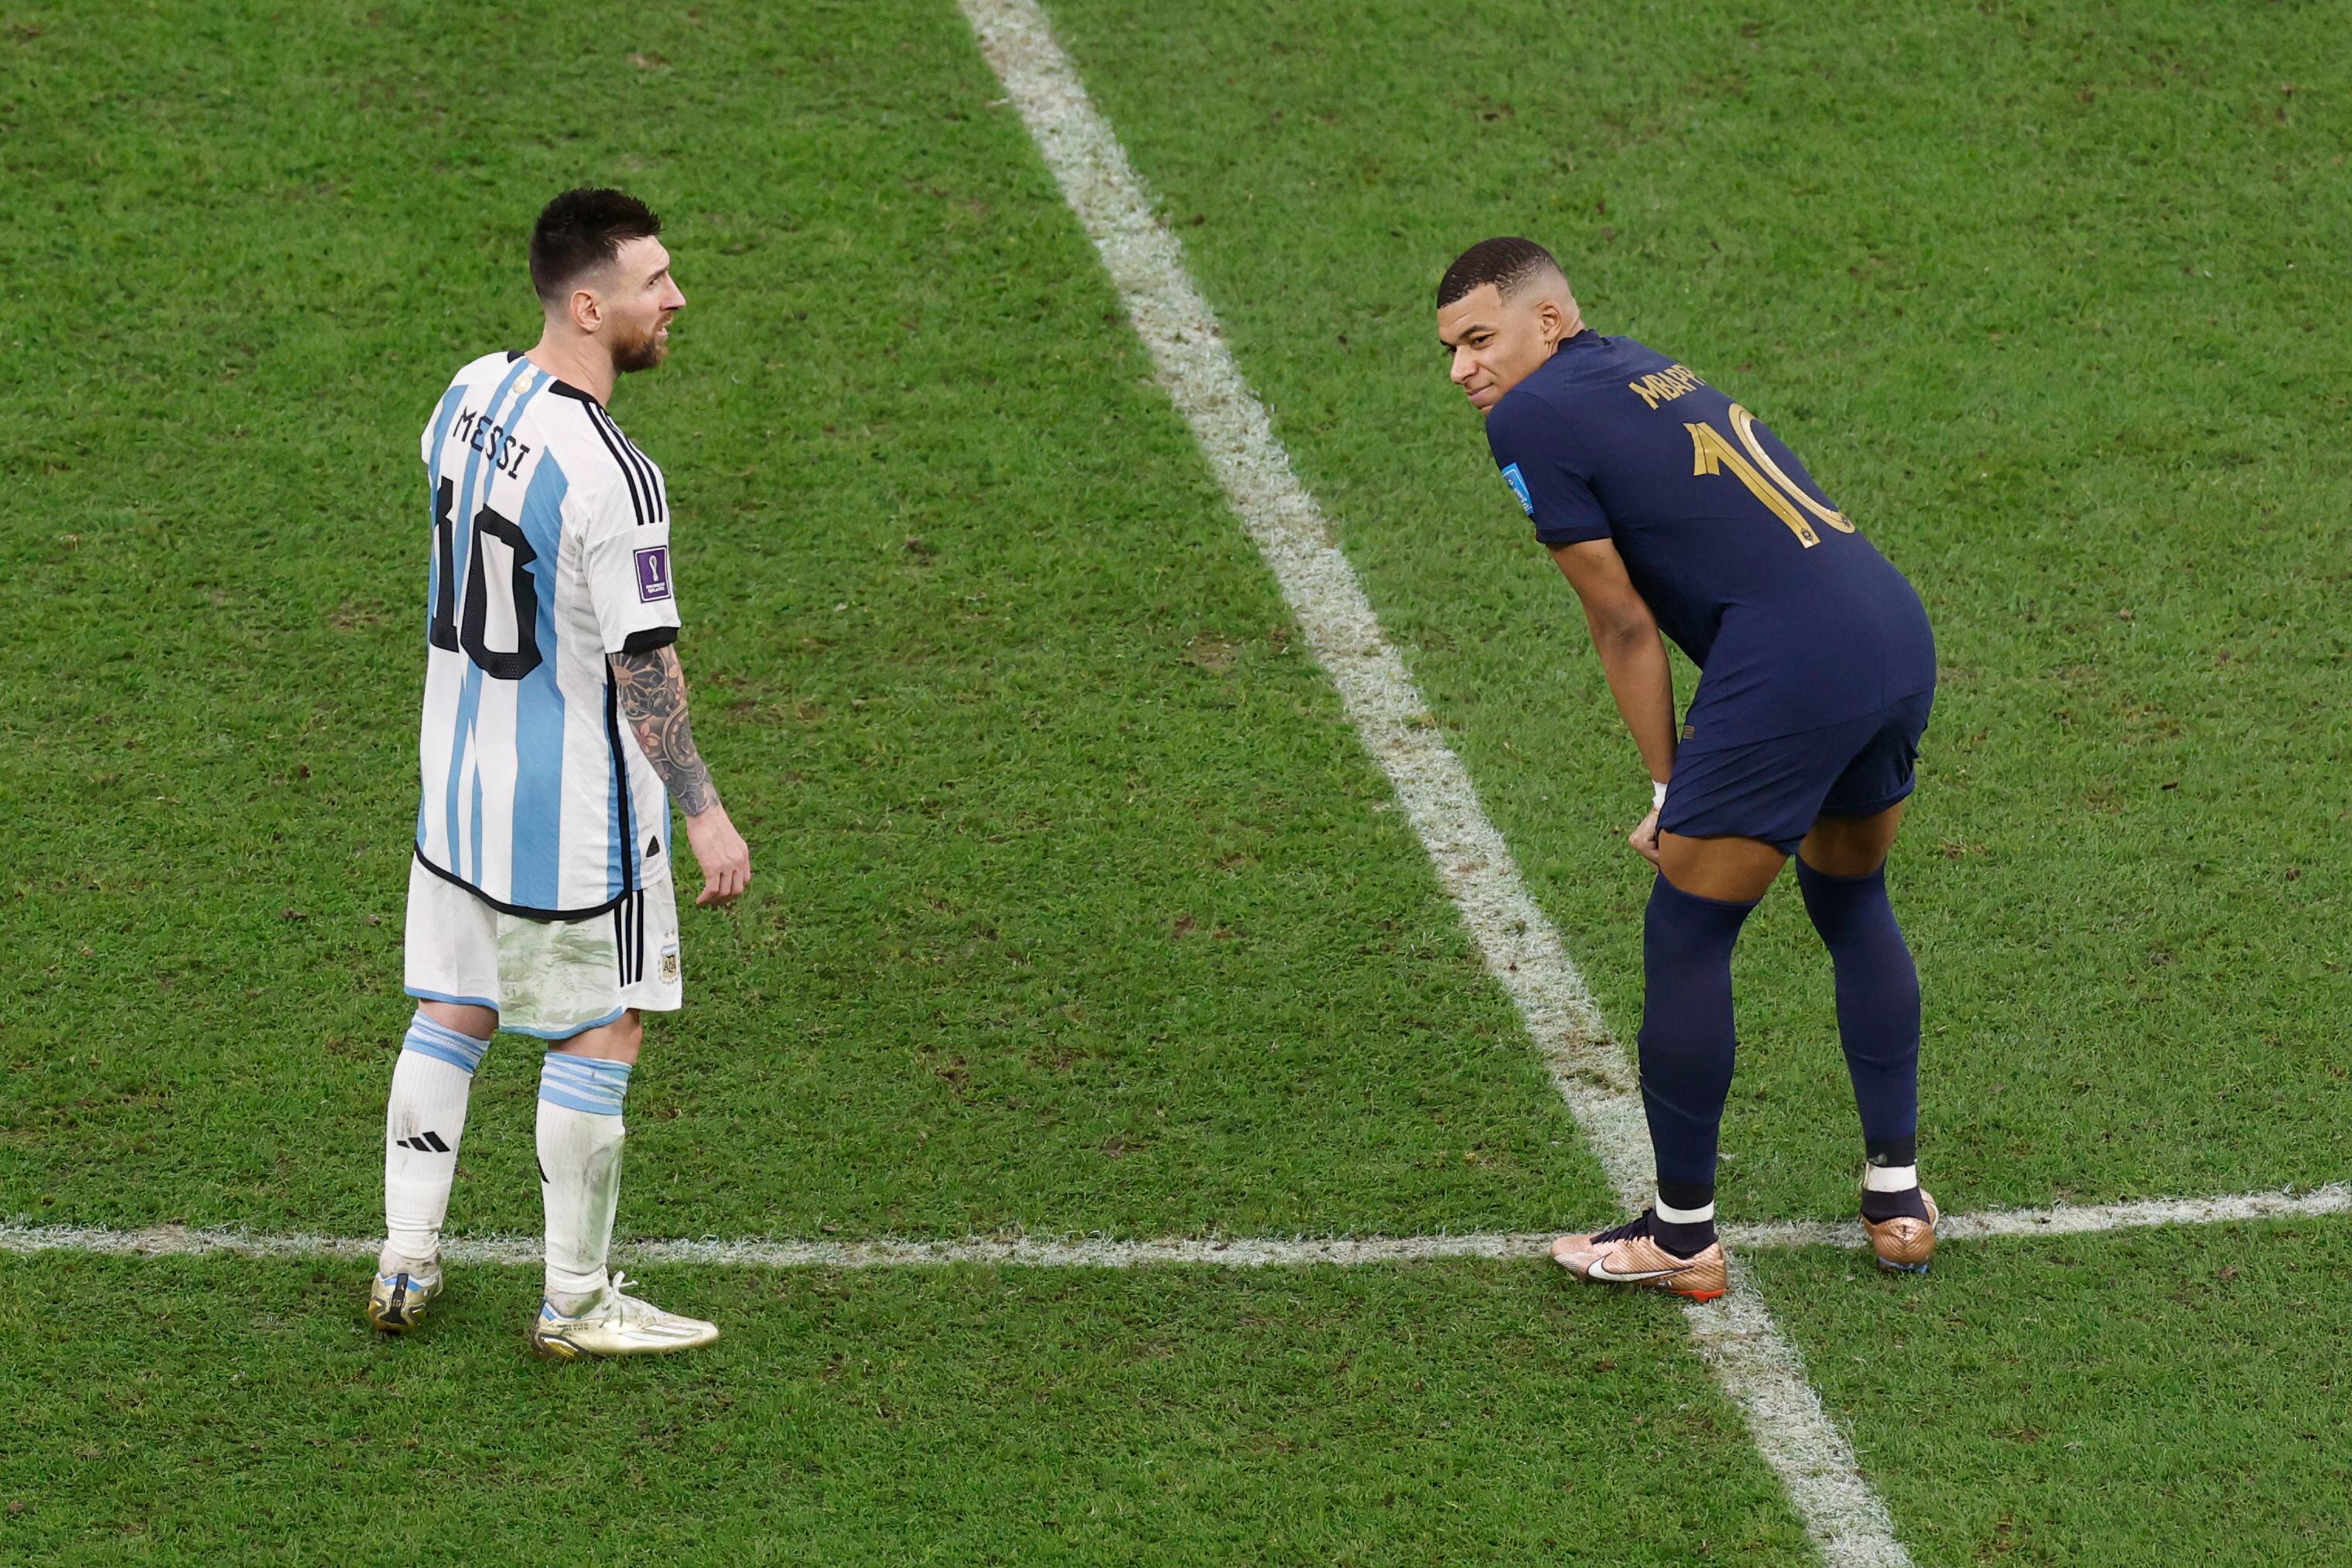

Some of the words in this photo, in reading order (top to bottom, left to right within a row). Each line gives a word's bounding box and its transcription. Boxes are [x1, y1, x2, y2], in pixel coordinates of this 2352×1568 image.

[1628, 364, 1707, 410] MBAPP
[453, 406, 530, 480] MESSI
[1682, 402, 1856, 549] 10
[429, 475, 543, 681] 10
